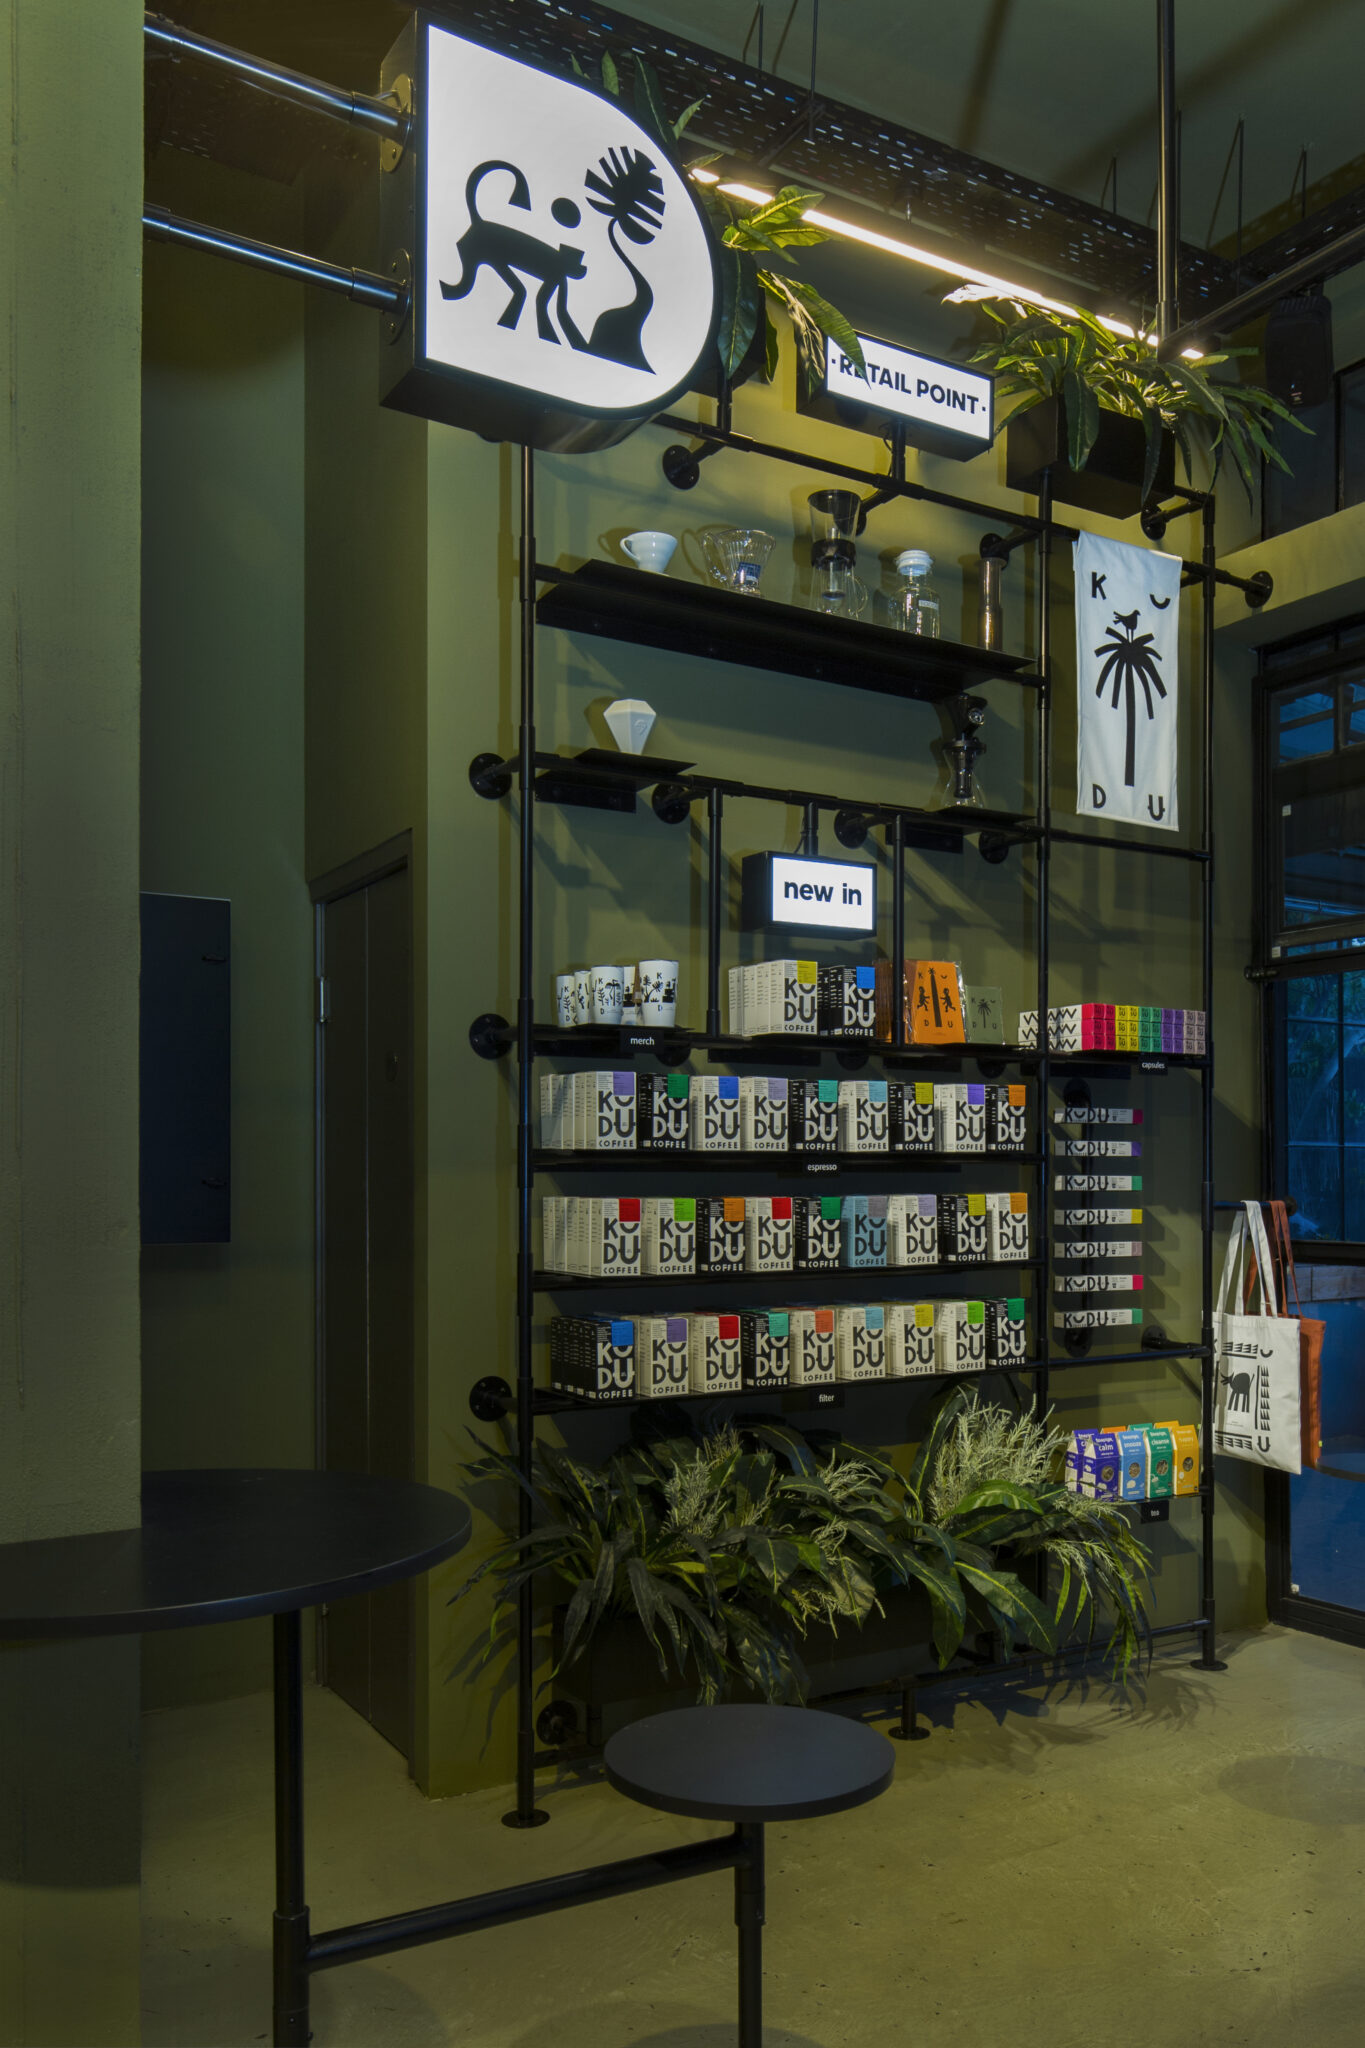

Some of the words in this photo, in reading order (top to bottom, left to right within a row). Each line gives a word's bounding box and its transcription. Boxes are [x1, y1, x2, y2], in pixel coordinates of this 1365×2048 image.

[917, 379, 979, 414] POINT
[1091, 571, 1107, 600] K
[1092, 783, 1107, 809] D
[1147, 794, 1166, 821] U
[784, 882, 833, 902] new
[843, 883, 861, 905] in
[785, 995, 816, 1023] DU
[844, 999, 875, 1027] DU
[630, 1037, 655, 1045] merch
[785, 1024, 815, 1032] COFFEE
[844, 1028, 873, 1036] COFFEE
[599, 1109, 636, 1138] DU
[653, 1110, 689, 1139] DU
[705, 1112, 739, 1139] DU
[754, 1113, 788, 1139] DU
[805, 1114, 838, 1141] DU
[857, 1115, 888, 1141] DU
[904, 1115, 934, 1142] DU
[956, 1117, 985, 1141] DU
[998, 1117, 1026, 1142] DU
[600, 1140, 634, 1148] COFFEE
[653, 1141, 686, 1149] COFFEE
[807, 1164, 838, 1173] espresso
[603, 1235, 640, 1264] DU
[660, 1235, 695, 1263] DU
[710, 1234, 745, 1262] DU
[758, 1232, 793, 1260] DU
[808, 1231, 841, 1259] DU
[855, 1230, 887, 1257] DU
[906, 1228, 937, 1254] DU
[957, 1227, 987, 1253] DU
[1000, 1225, 1028, 1250] DU
[808, 1260, 840, 1268] COFFEE
[1000, 1251, 1027, 1259] COFFEE
[660, 1265, 693, 1273] COFFEE
[853, 1341, 884, 1368] DU
[904, 1338, 934, 1365] DU
[956, 1334, 985, 1361] DU
[997, 1330, 1026, 1357] DU
[652, 1354, 688, 1384] DU
[706, 1351, 741, 1381] DU
[755, 1348, 789, 1377] DU
[803, 1344, 834, 1372] DU
[998, 1358, 1025, 1366] COFFEE
[597, 1359, 635, 1390] DU
[706, 1382, 739, 1390] COFFEE
[756, 1378, 788, 1386] COFFEE
[804, 1373, 833, 1381] COFFEE
[854, 1369, 883, 1377] COFFEE
[598, 1390, 633, 1399] COFFEE
[653, 1385, 686, 1394] COFFEE
[819, 1394, 835, 1403] filter
[1099, 1443, 1114, 1451] calm
